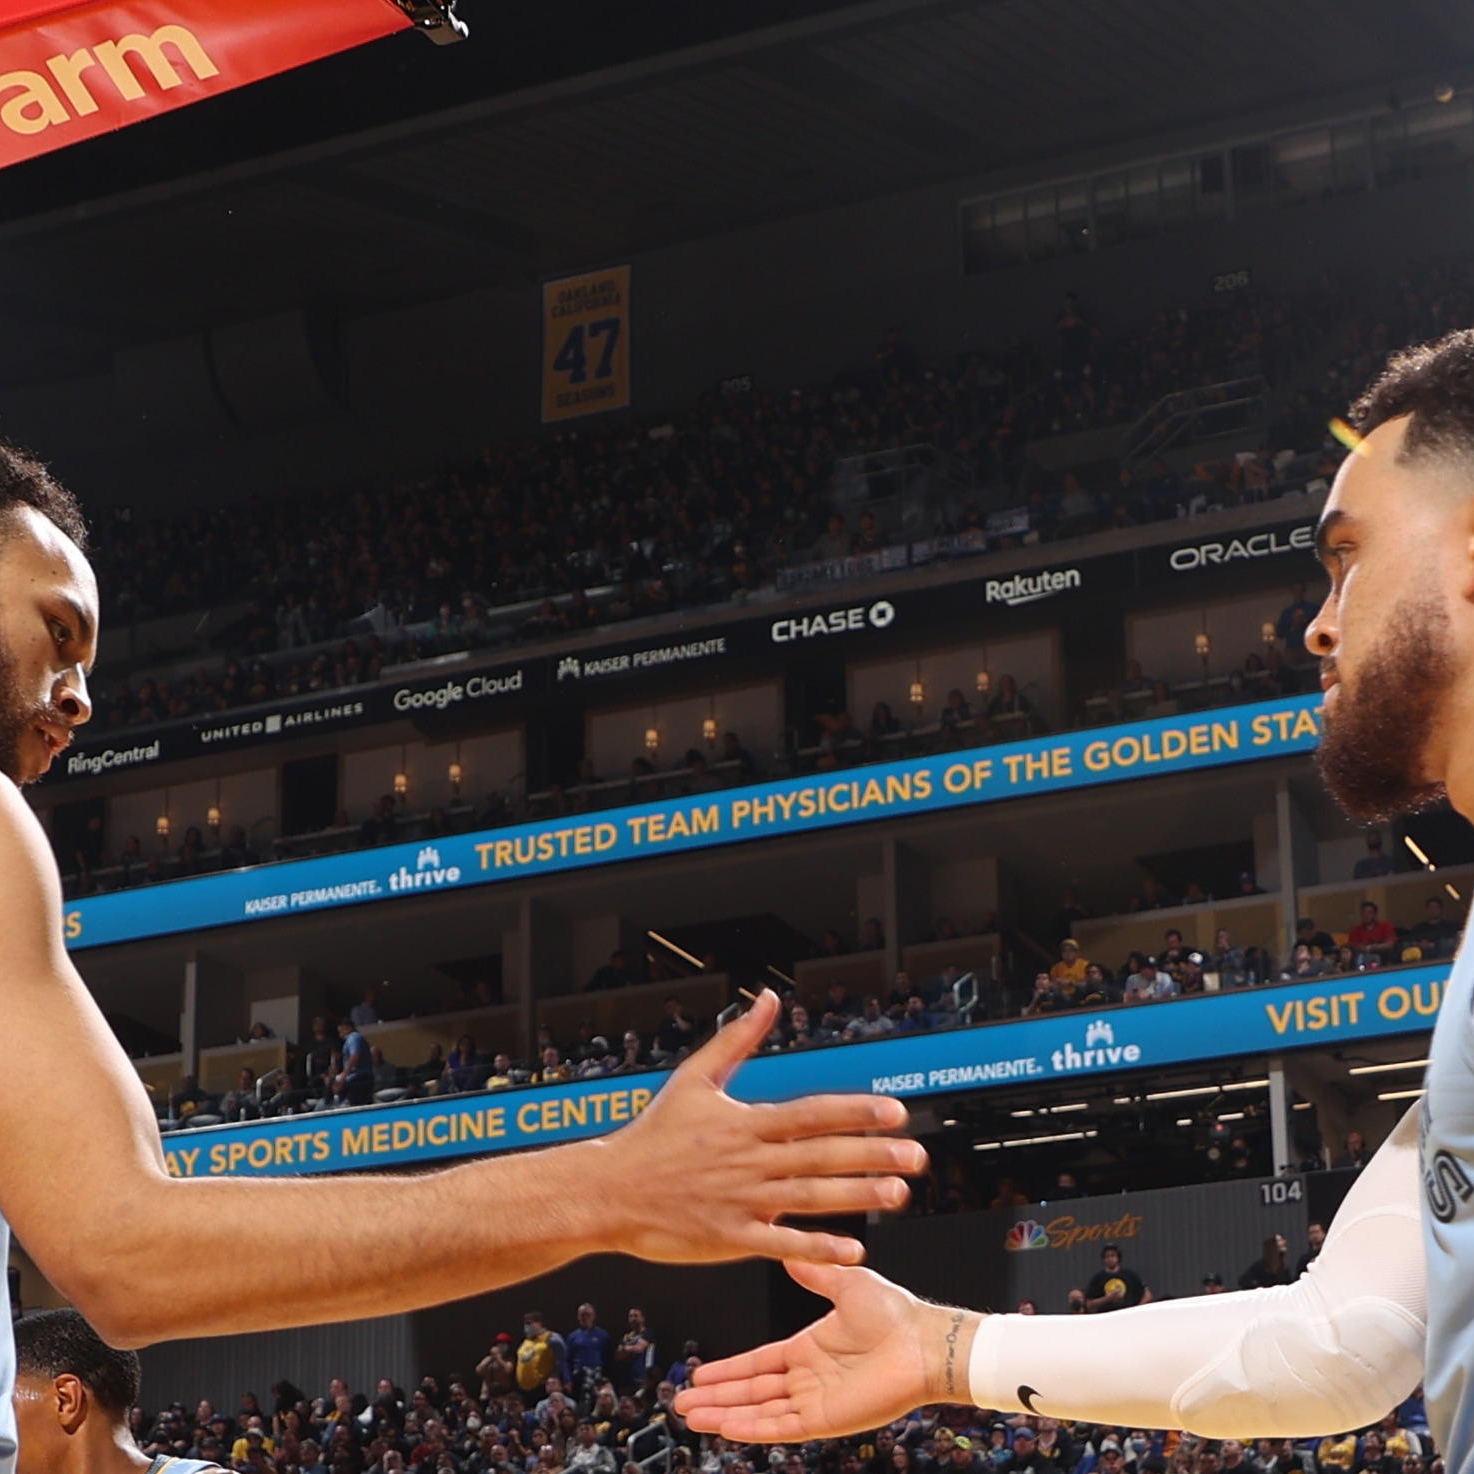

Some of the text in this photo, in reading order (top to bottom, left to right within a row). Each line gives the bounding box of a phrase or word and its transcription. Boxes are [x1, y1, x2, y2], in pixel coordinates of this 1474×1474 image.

[552, 316, 621, 384] 47
[1170, 524, 1316, 571] ORACLE
[985, 566, 1082, 605] Rakuten
[771, 606, 865, 643] CHASE
[583, 636, 726, 678] KAISER PERMANENTE
[393, 670, 523, 712] Google Cloud
[201, 701, 364, 742] UNITED AIRLINES
[68, 740, 160, 775] RingCentral
[474, 822, 618, 871] TRUSTED
[626, 804, 720, 845] TEAM
[732, 768, 931, 830] PHYSICIANS
[943, 760, 992, 793] OF
[1003, 747, 1074, 784] THE
[1083, 720, 1240, 772] GOLDEN
[244, 892, 288, 915] KAISER
[389, 863, 461, 893] thrive
[1265, 983, 1447, 1035] VISIT OU
[872, 1072, 926, 1095] KAISER
[1051, 1040, 1141, 1072] thrive
[162, 1145, 201, 1178] AY
[209, 1129, 330, 1175] SPORTS
[341, 1107, 507, 1158] MEDICINE
[1260, 1178, 1303, 1206] 104
[1044, 1211, 1145, 1251] Sports
